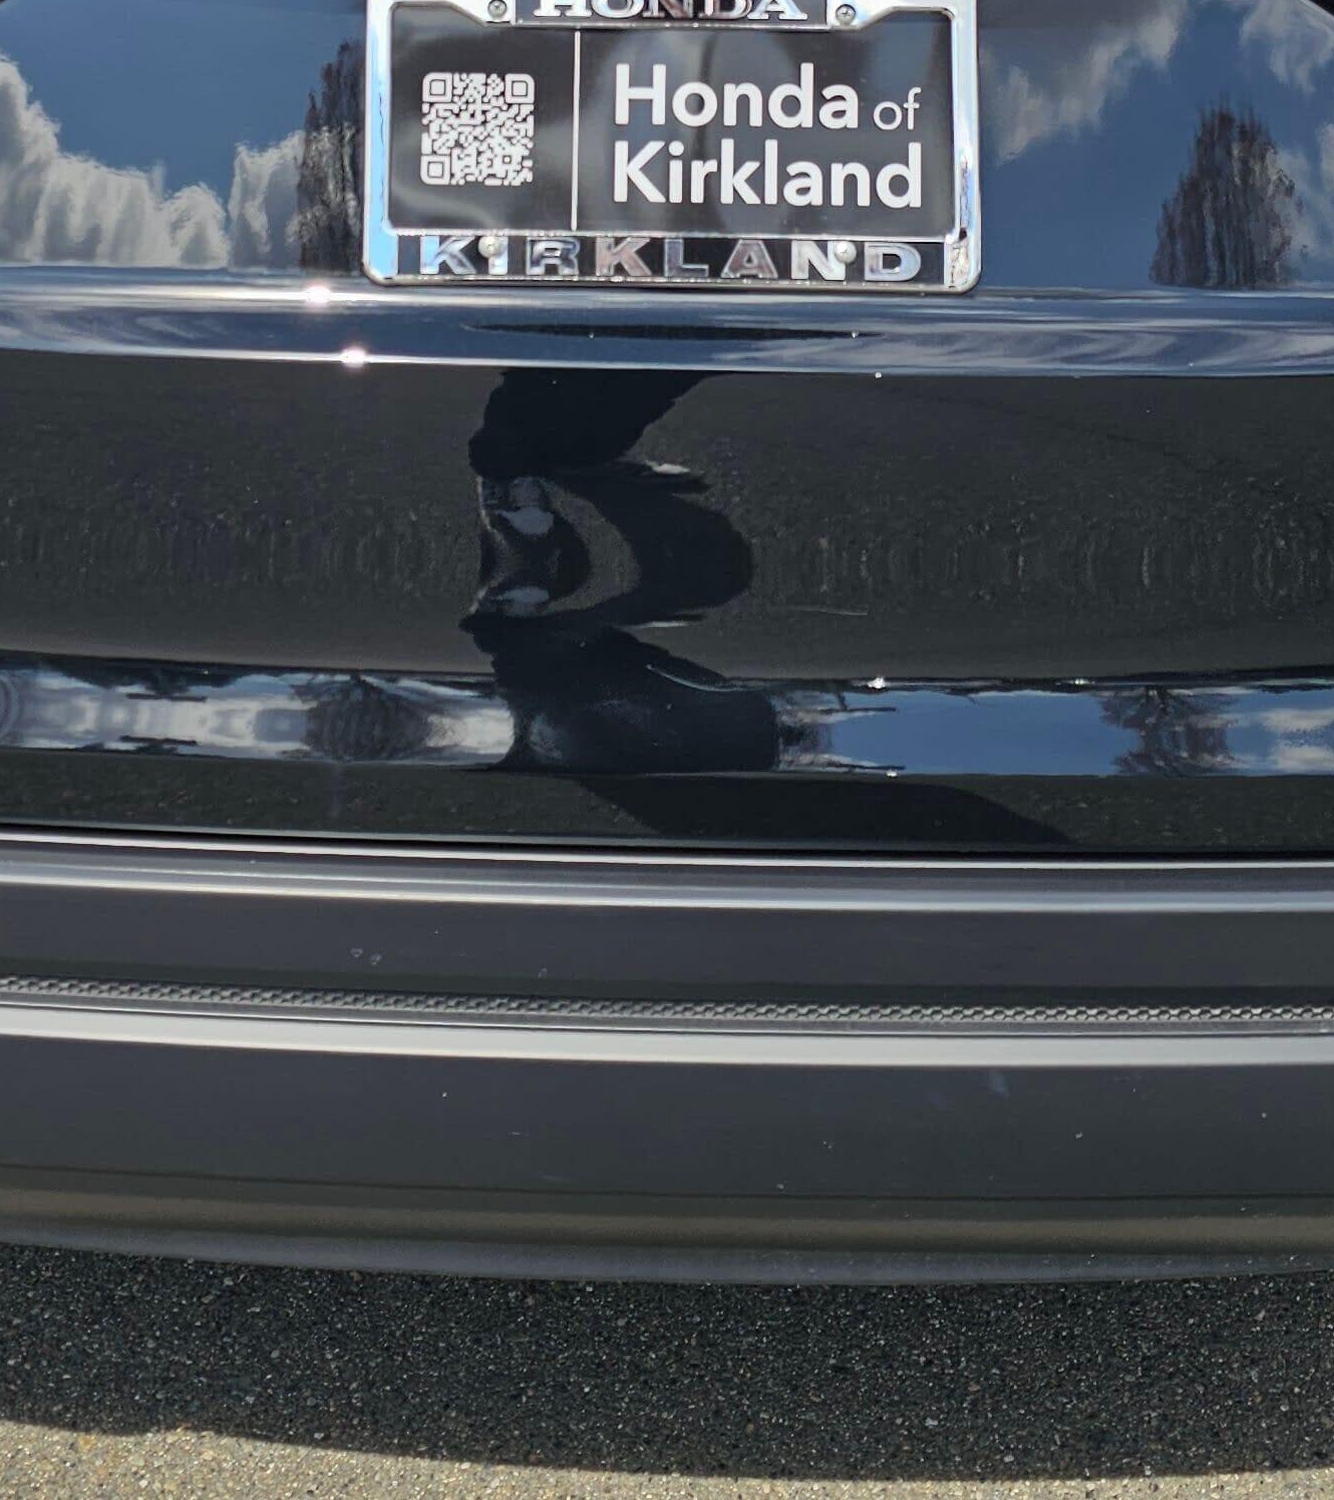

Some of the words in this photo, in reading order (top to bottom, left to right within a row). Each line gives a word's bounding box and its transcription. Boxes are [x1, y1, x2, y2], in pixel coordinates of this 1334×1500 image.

[613, 62, 859, 130] Honda
[872, 86, 922, 131] of
[612, 139, 922, 209] Kirkland
[419, 236, 922, 283] KIRKLAND
